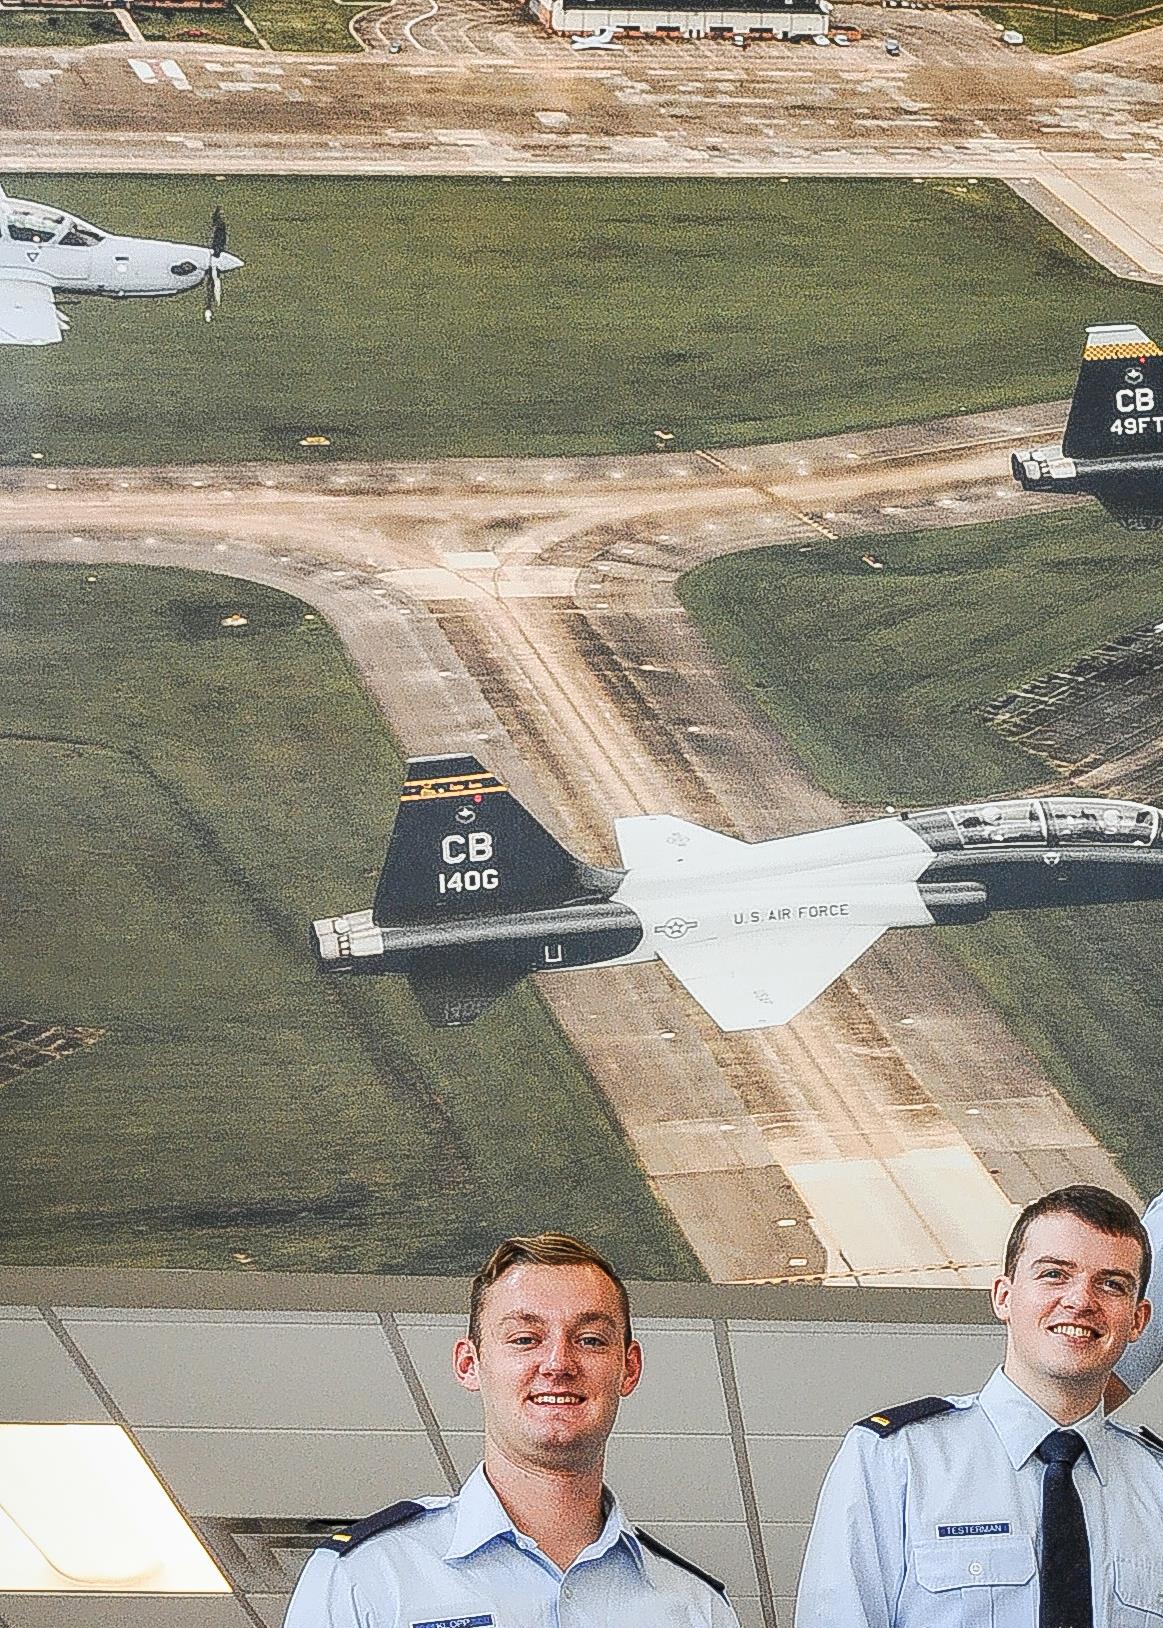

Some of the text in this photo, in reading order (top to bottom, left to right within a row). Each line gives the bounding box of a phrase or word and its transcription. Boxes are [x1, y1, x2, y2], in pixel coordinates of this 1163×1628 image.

[1115, 387, 1155, 413] CB
[441, 831, 493, 865] CB
[768, 908, 791, 921] AIR
[798, 903, 850, 919] FORCE
